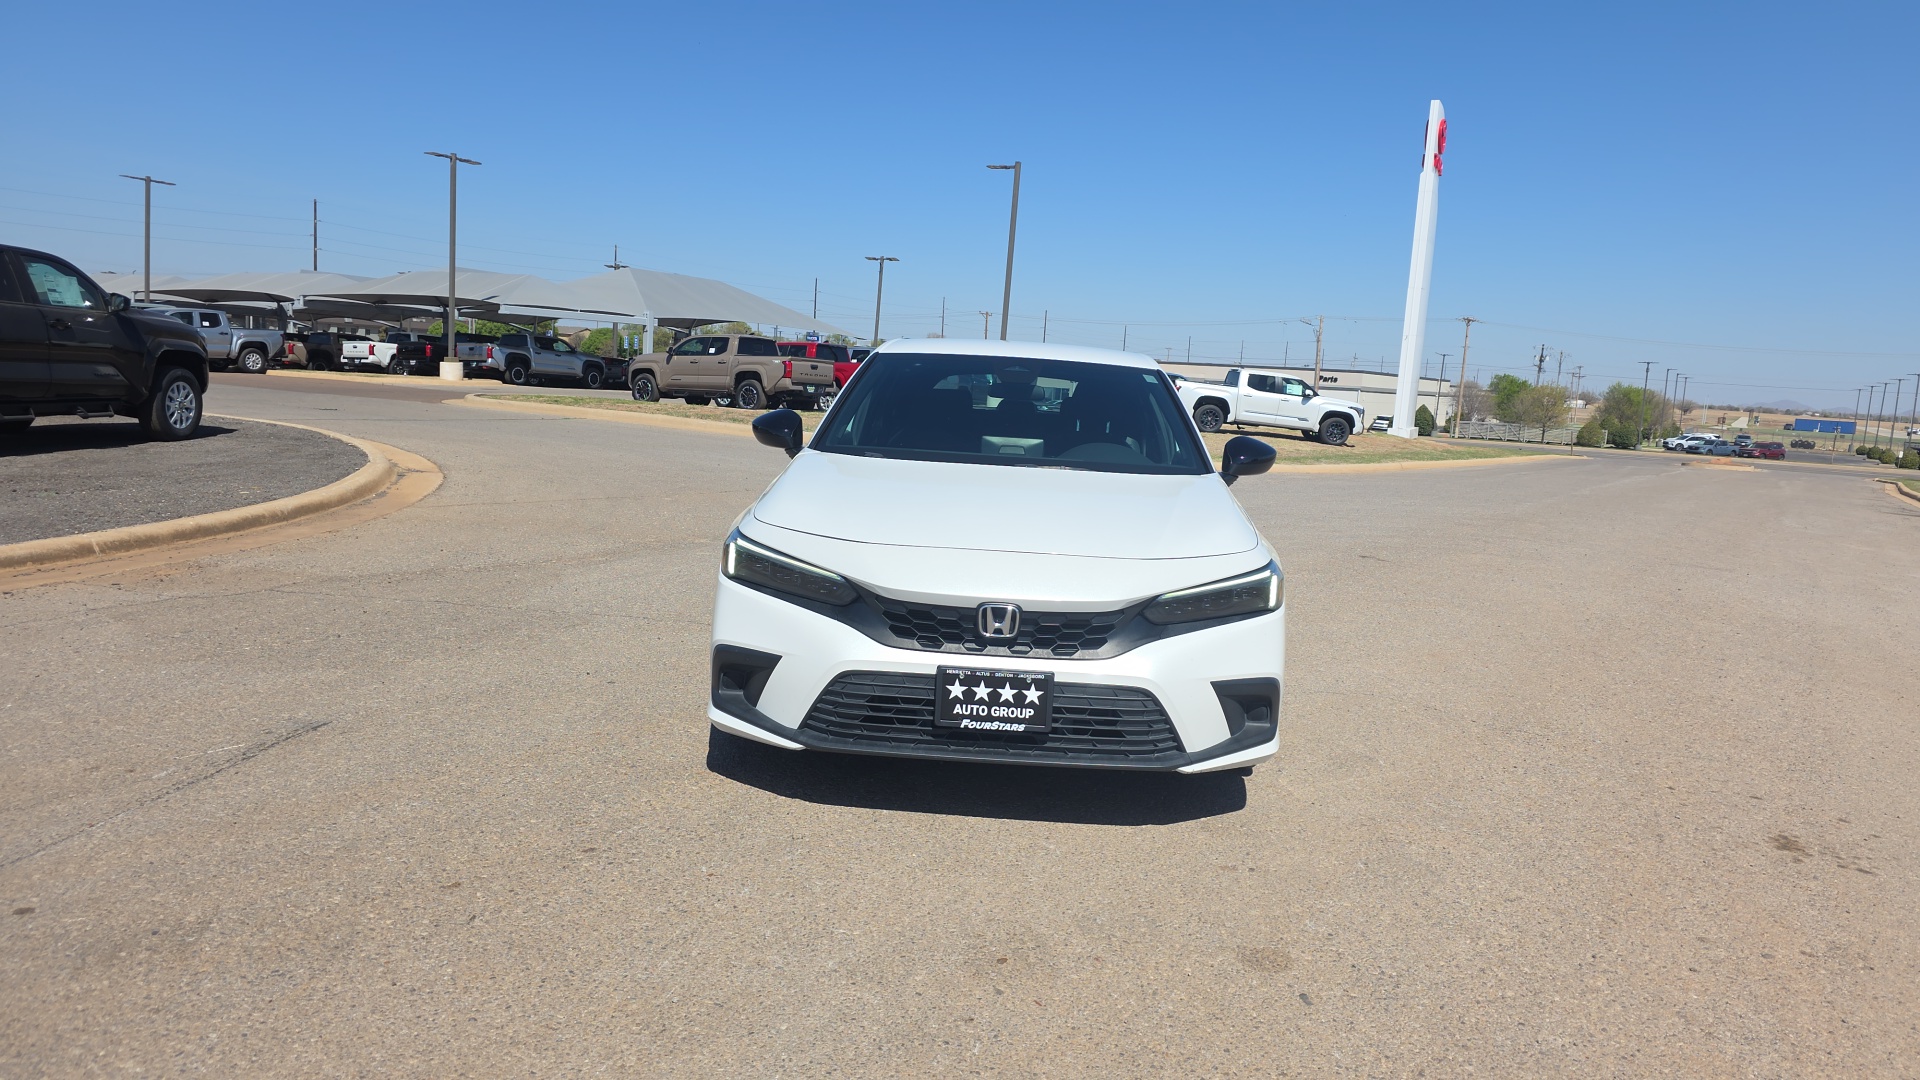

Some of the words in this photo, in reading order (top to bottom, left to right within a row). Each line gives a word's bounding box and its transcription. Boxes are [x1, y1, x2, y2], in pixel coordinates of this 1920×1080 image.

[1319, 375, 1338, 383] Parts
[953, 704, 988, 716] AUTO
[991, 706, 1034, 719] GROUP
